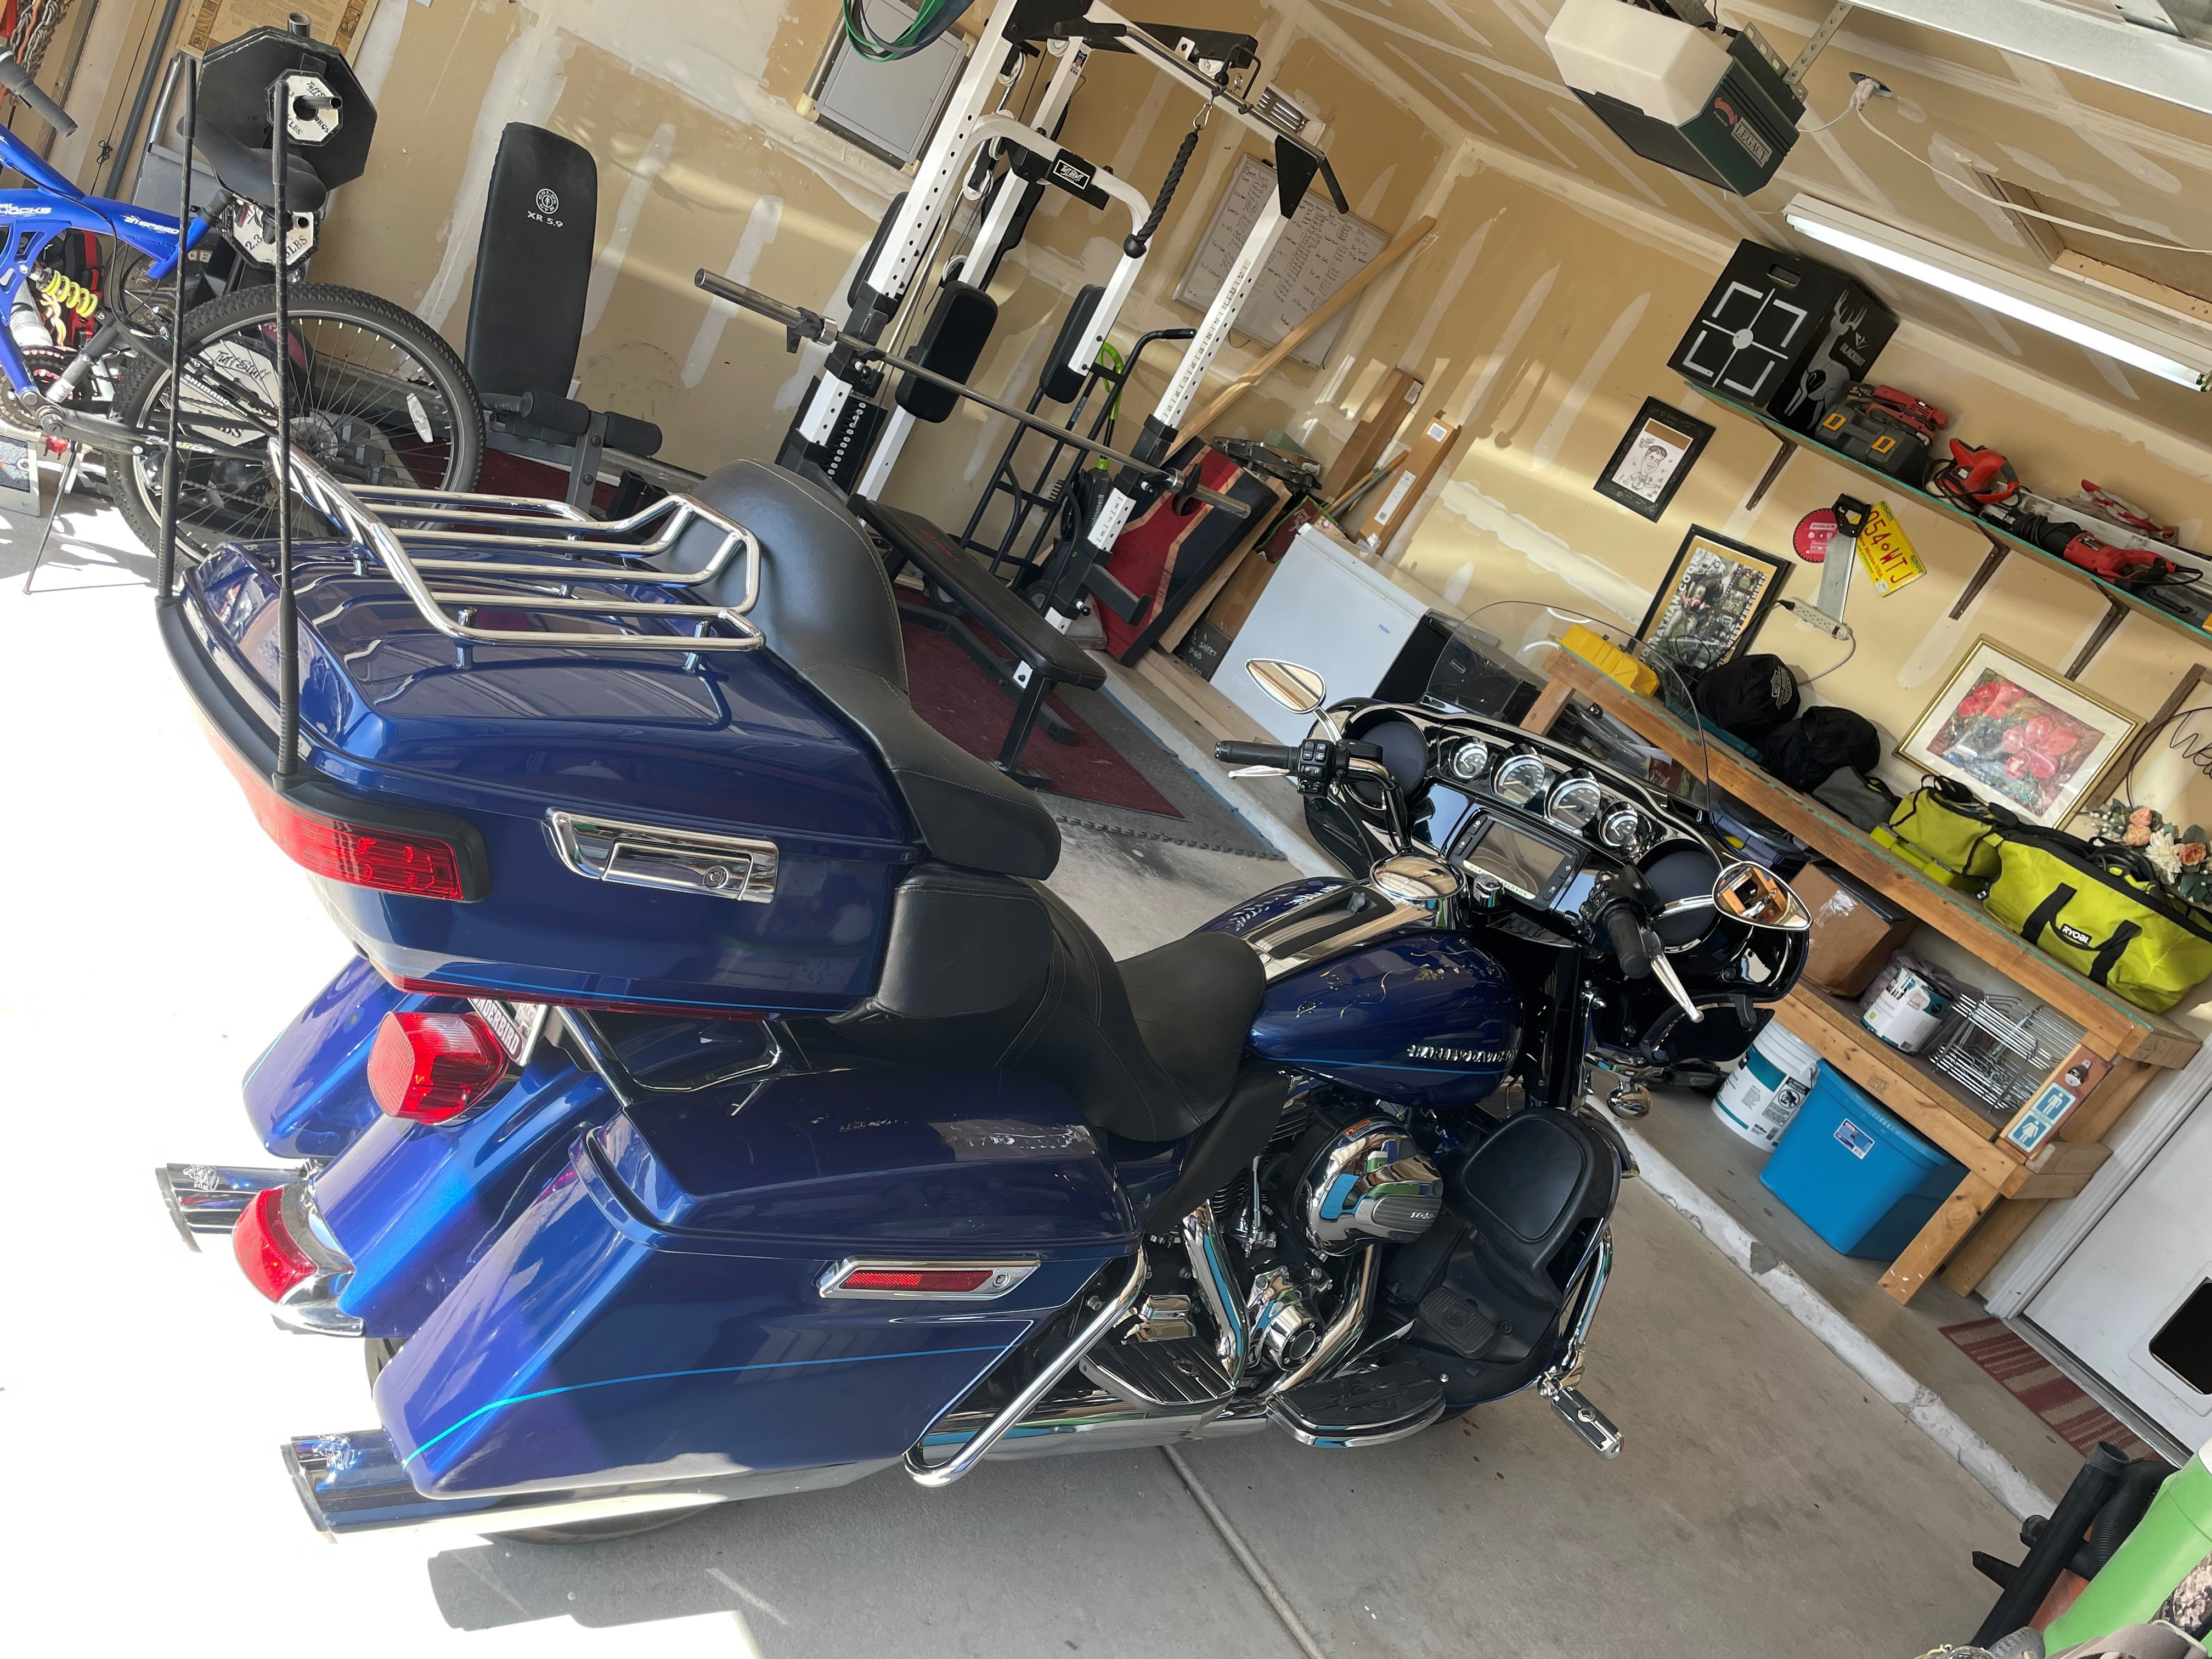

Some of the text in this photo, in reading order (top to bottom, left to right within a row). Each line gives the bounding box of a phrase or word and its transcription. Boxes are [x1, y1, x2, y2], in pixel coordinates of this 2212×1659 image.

[318, 120, 330, 133] KGS
[1735, 124, 1767, 160] LEGACY
[138, 221, 180, 234] SPEED
[527, 211, 563, 228] XR 5.9
[245, 234, 263, 251] 2.3
[1839, 342, 1866, 366] BLACKOUT
[1727, 573, 1768, 648] WEST FRESHMEN
[2062, 925, 2089, 944] RYOBI
[473, 998, 520, 1055] NDERBIRD
